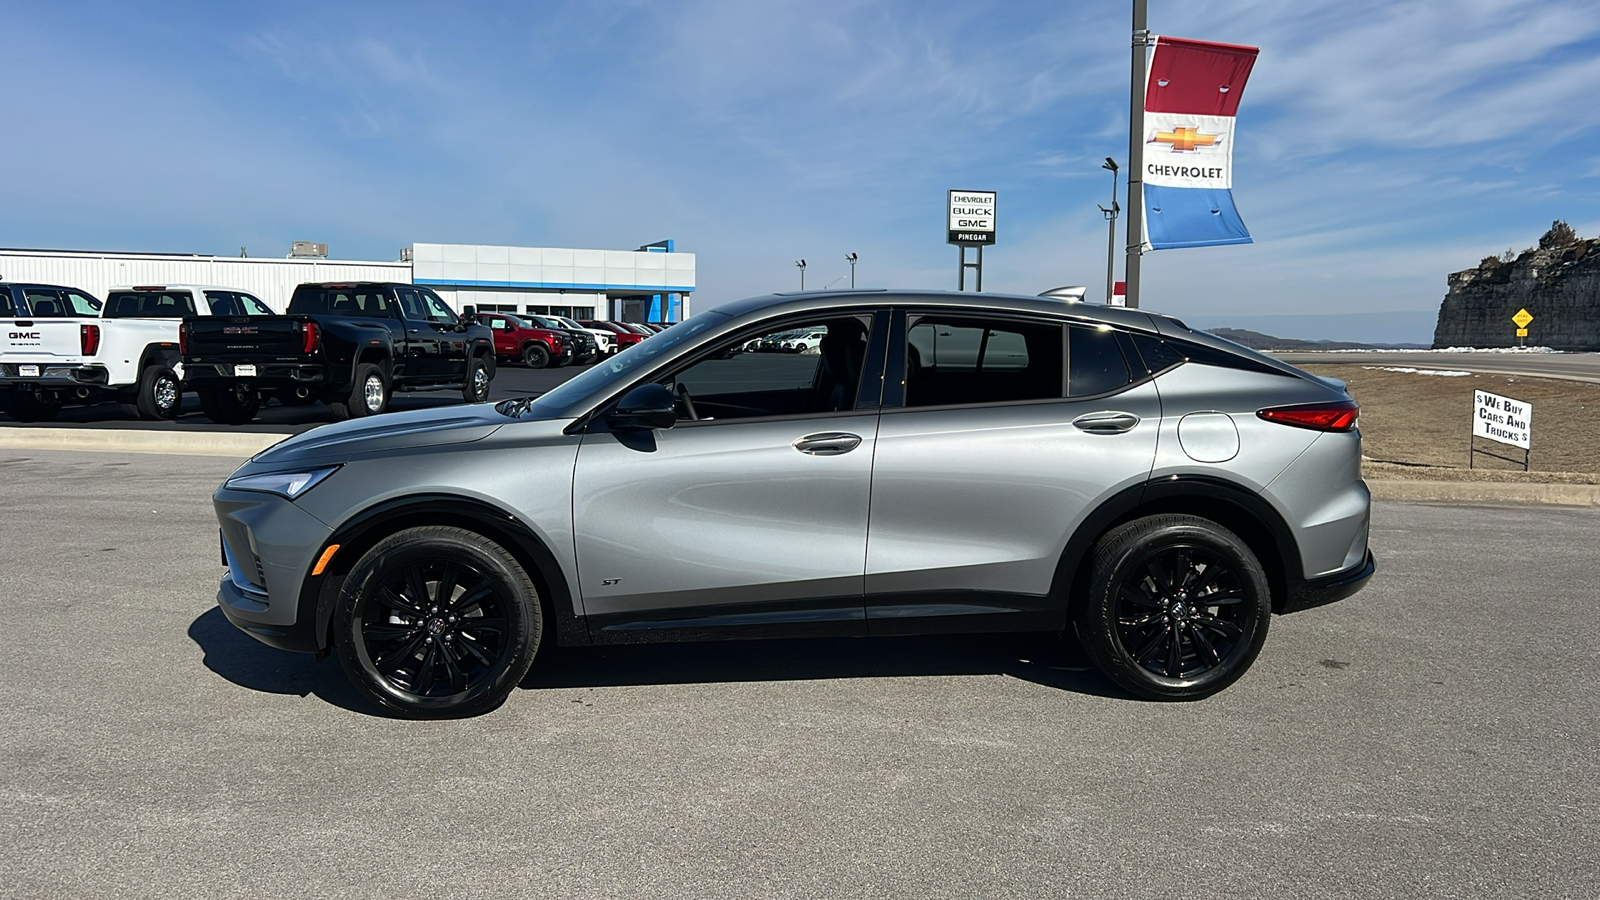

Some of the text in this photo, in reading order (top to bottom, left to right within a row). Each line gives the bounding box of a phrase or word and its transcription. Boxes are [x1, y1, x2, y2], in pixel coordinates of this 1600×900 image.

[1147, 163, 1223, 179] CHEVROLET
[954, 195, 992, 204] CHEVROLET
[953, 207, 992, 216] BUICK
[958, 219, 987, 228] GMC
[601, 578, 622, 586] ST
